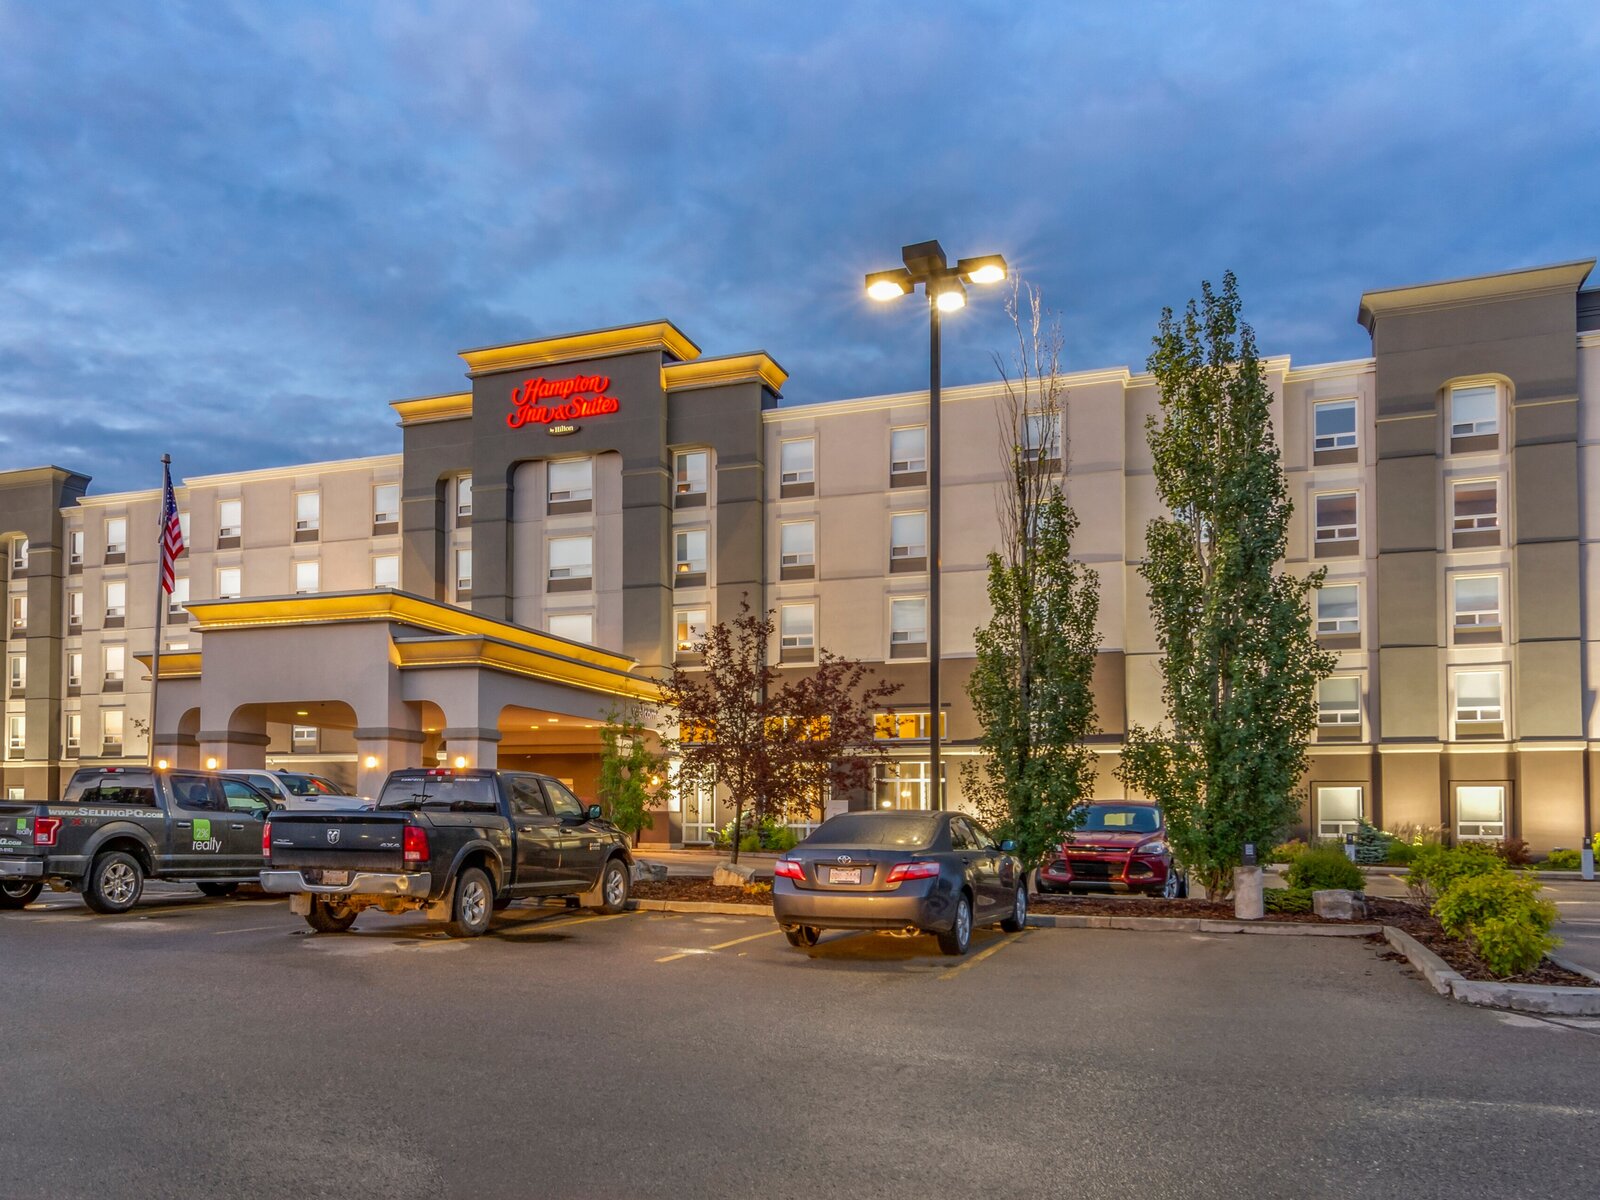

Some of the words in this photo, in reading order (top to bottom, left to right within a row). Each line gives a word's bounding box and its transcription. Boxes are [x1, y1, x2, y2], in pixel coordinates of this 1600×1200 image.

[512, 375, 609, 406] Hampton
[507, 404, 555, 428] Inn
[566, 395, 619, 419] Suites
[555, 424, 574, 433] Hilton
